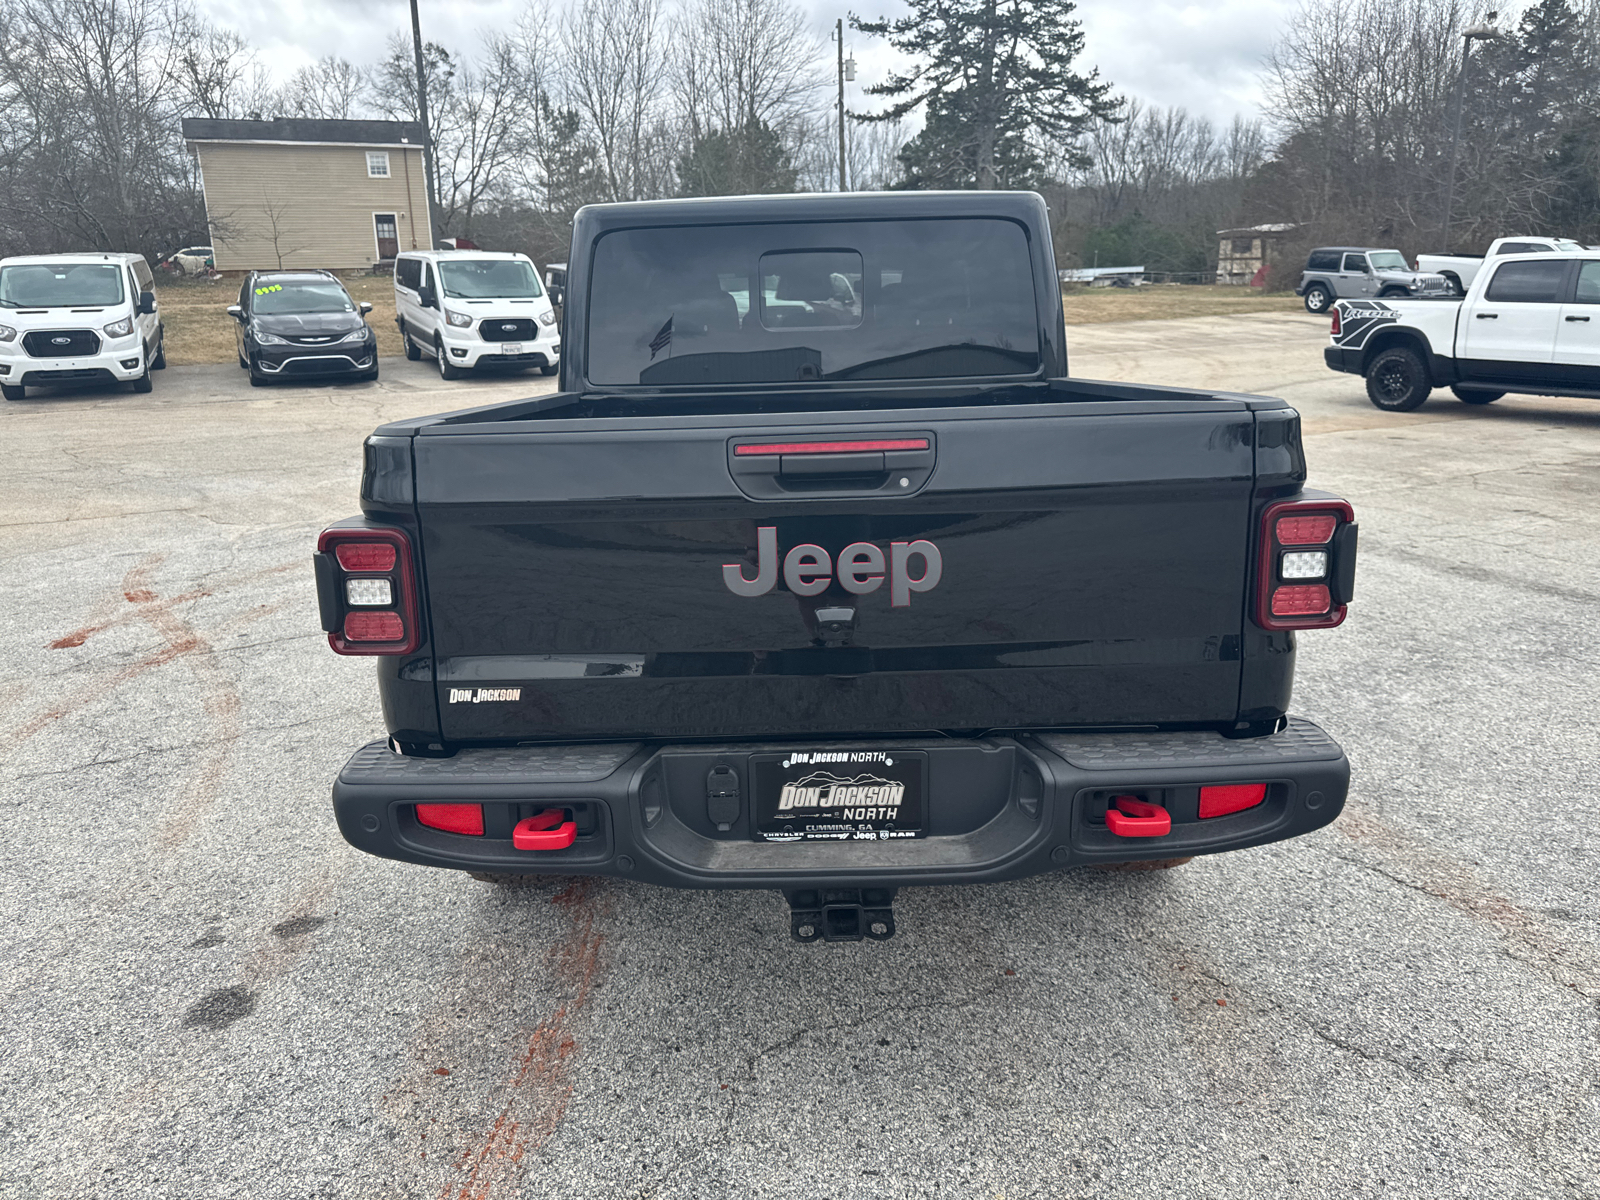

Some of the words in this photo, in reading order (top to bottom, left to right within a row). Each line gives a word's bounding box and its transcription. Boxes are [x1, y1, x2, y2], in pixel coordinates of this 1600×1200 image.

[255, 284, 282, 295] 8995
[722, 527, 943, 607] Jeep
[449, 688, 472, 703] DON
[472, 688, 521, 703] JACKSON
[790, 752, 809, 765] DON
[850, 752, 886, 763] NORTH
[778, 785, 820, 810] DON
[820, 785, 905, 807] JACKSON
[843, 807, 898, 821] NORTH
[858, 823, 873, 831] GA
[853, 831, 876, 840] Jeep
